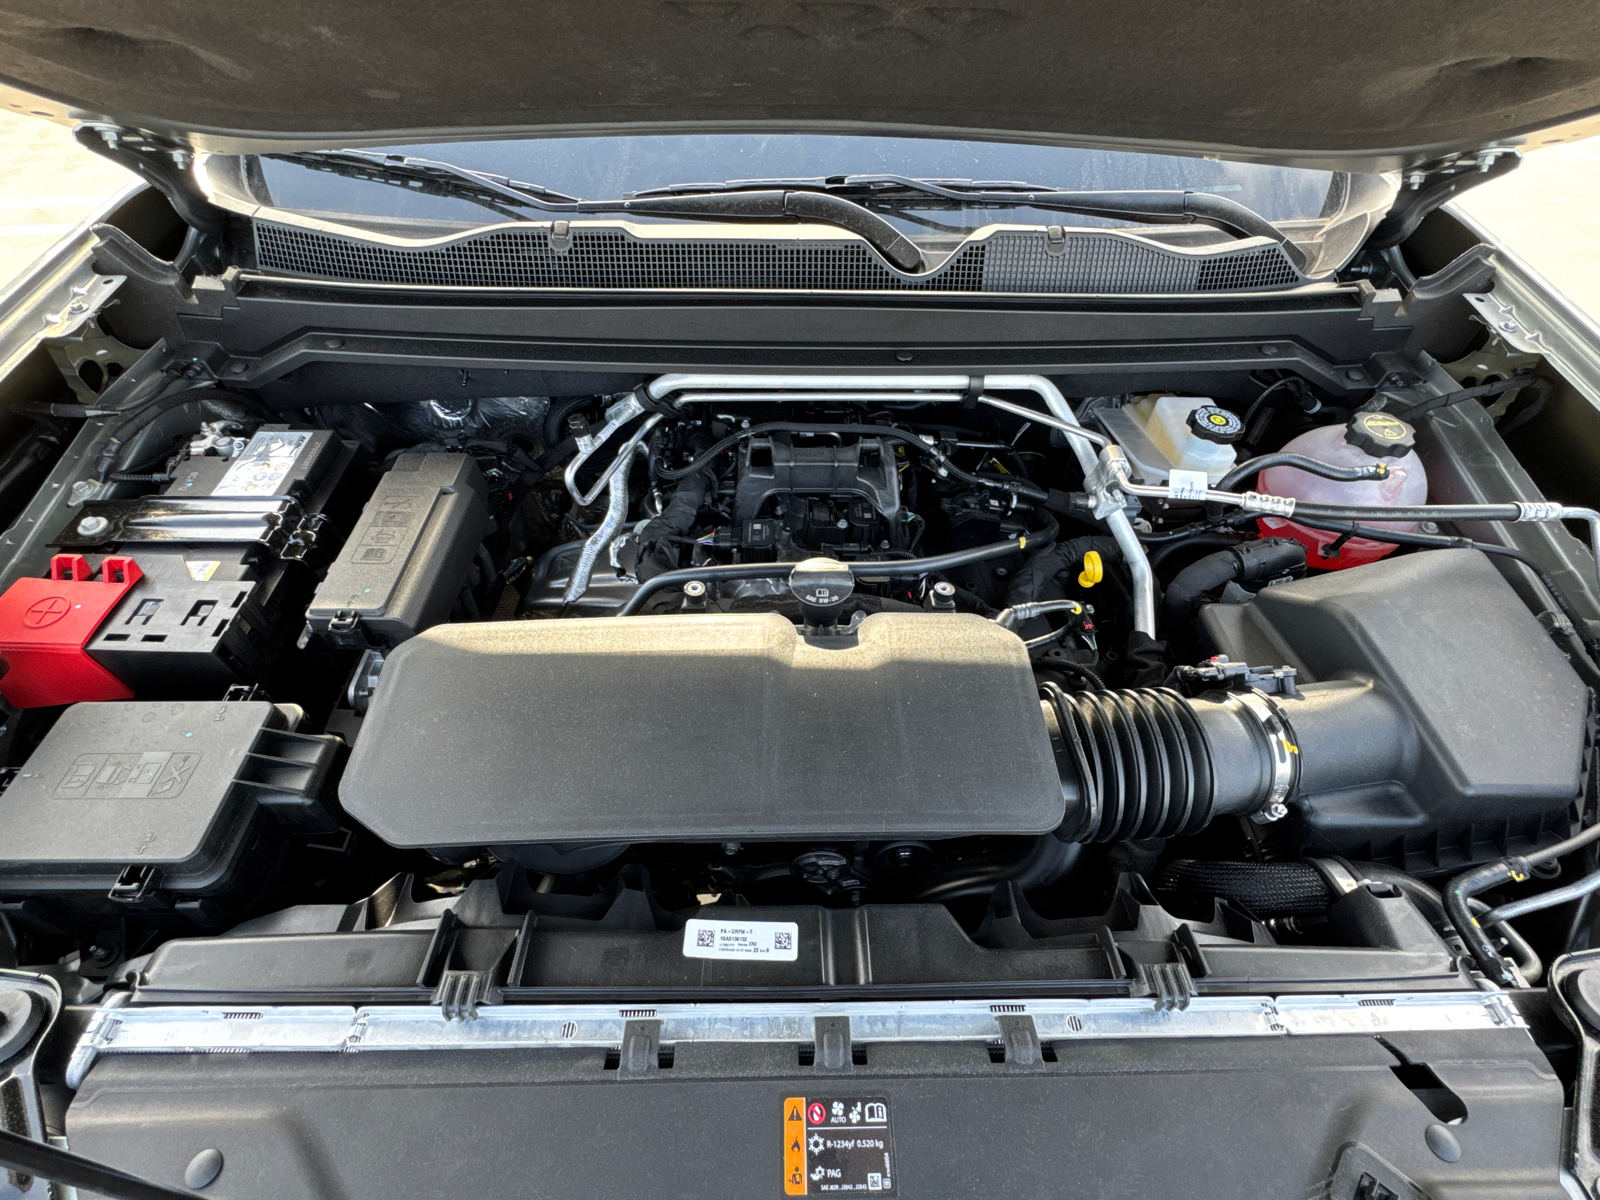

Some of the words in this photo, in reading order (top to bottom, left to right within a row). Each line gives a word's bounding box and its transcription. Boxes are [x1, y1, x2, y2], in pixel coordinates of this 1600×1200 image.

[826, 1139, 855, 1149] R-1234yf
[856, 1139, 875, 1148] 0.520
[875, 1139, 884, 1149] kg
[827, 1169, 842, 1178] PAG
